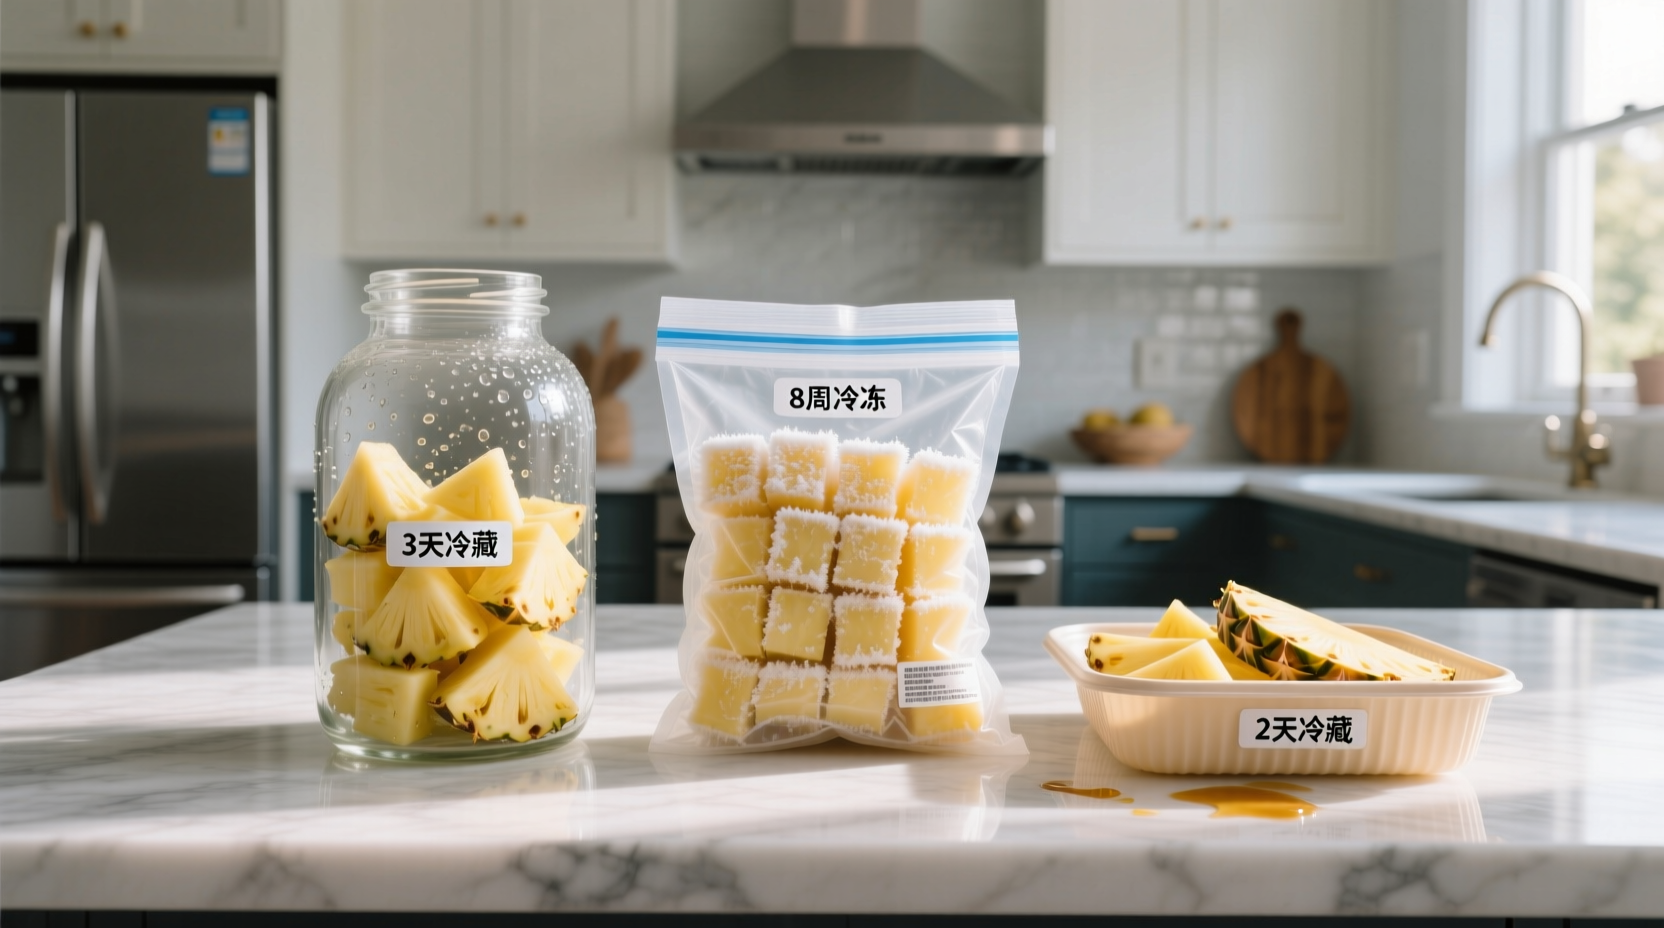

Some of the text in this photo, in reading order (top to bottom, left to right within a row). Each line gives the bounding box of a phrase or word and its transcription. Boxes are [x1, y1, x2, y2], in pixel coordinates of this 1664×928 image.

[789, 384, 887, 412] 8周冷冻
[401, 529, 499, 559] 3天冷藏
[1254, 714, 1354, 744] 2天冷藏
